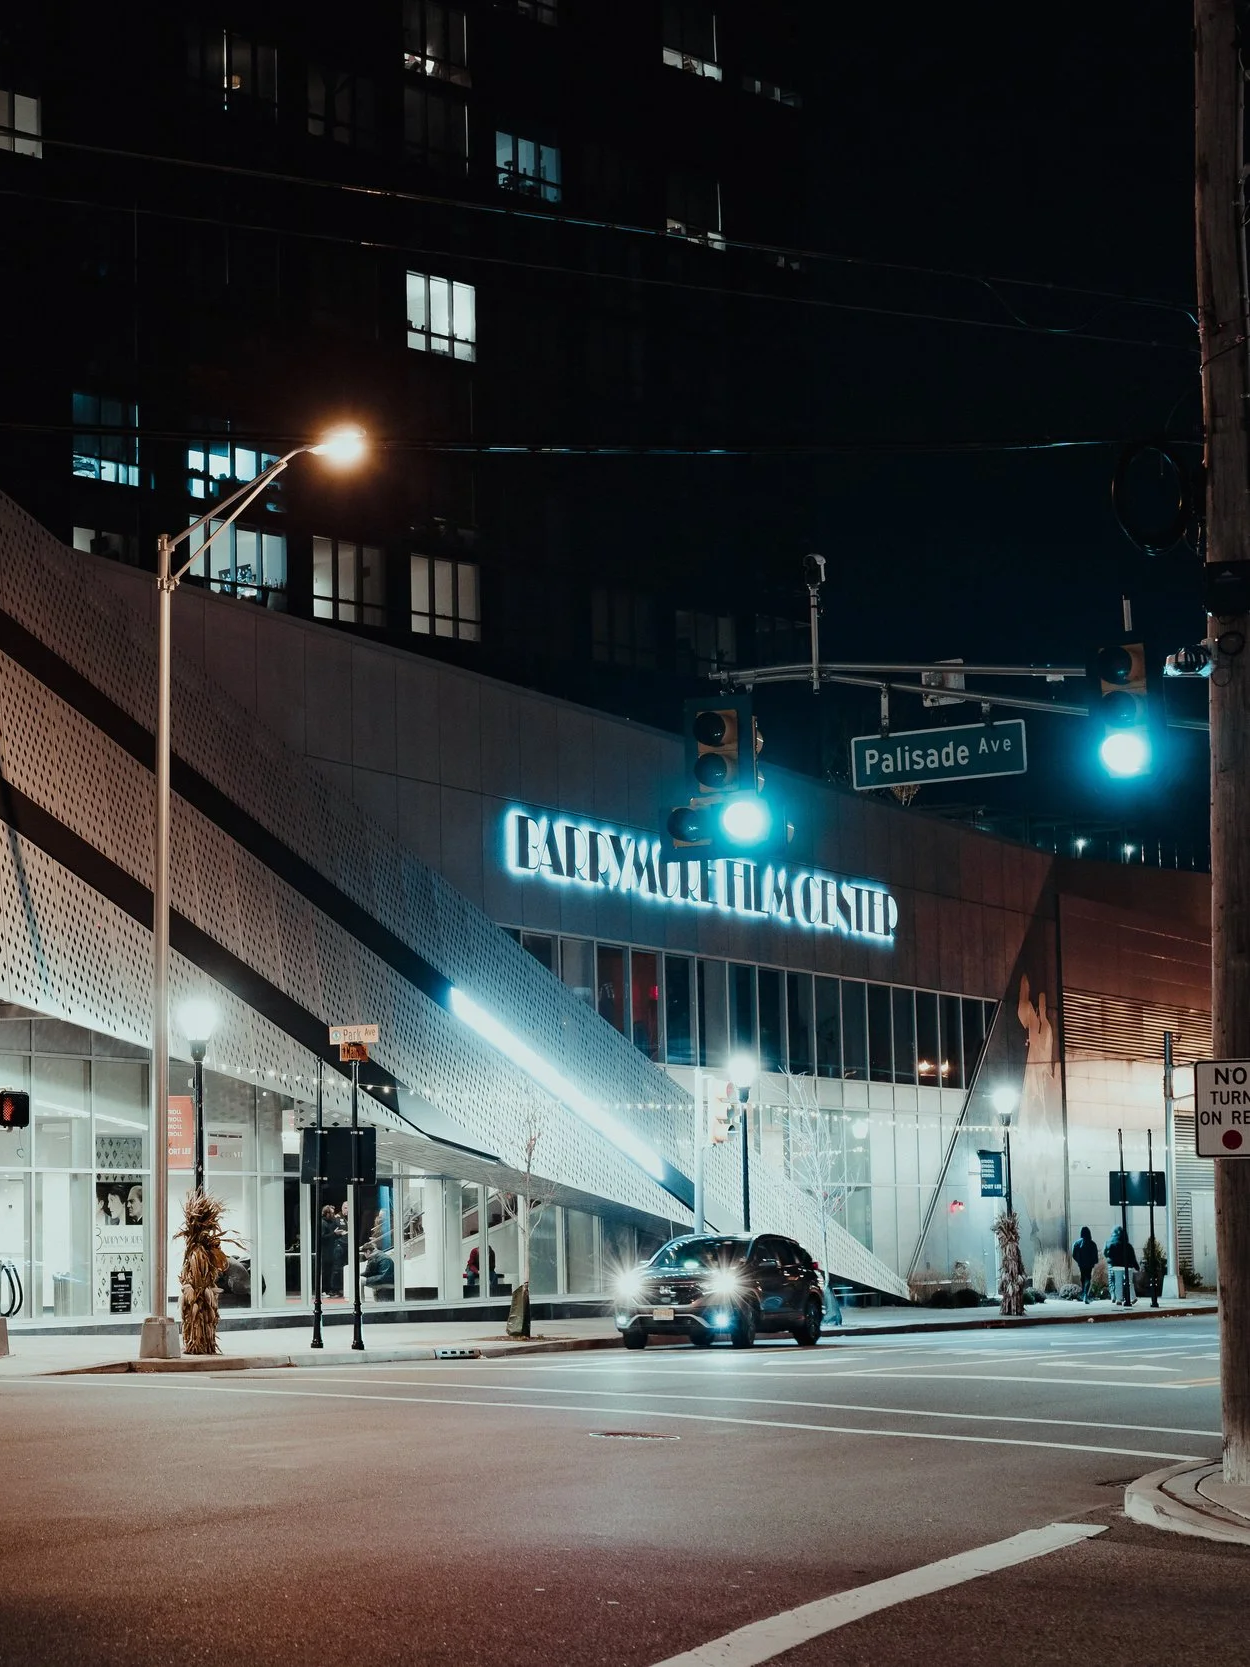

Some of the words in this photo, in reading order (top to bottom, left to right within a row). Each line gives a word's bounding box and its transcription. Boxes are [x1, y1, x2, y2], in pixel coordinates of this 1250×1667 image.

[865, 741, 969, 775] Palisade
[978, 737, 1012, 754] Ave
[725, 857, 796, 919] FILM
[802, 875, 899, 937] CENTER
[343, 1029, 362, 1041] Park
[364, 1028, 376, 1036] Ave
[1214, 1067, 1247, 1085] NO
[1210, 1090, 1250, 1105] TURN
[1200, 1111, 1221, 1125] ON
[1232, 1111, 1250, 1125] RE
